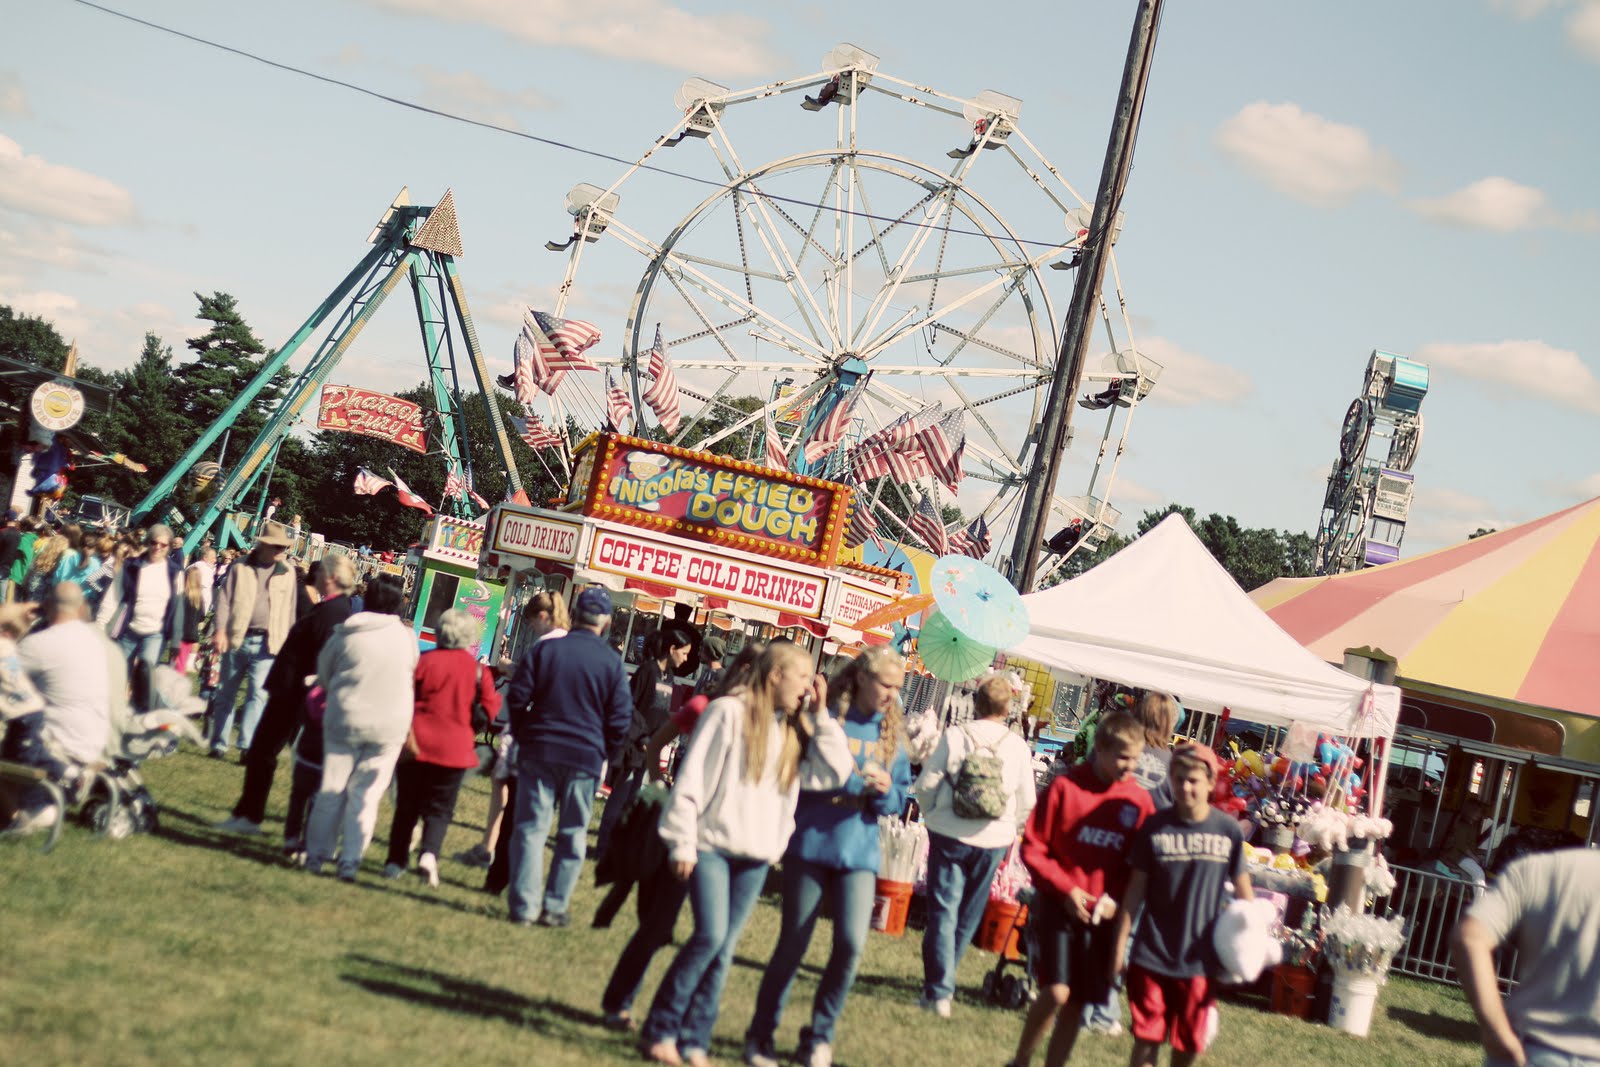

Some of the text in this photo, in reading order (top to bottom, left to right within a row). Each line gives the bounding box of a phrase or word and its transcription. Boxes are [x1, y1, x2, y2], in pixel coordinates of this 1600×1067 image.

[320, 387, 435, 431] Pharaoh's
[347, 409, 406, 439] Fury
[619, 467, 815, 513] Nicola's FRIED
[503, 520, 575, 555] COLD DRINKS
[691, 494, 818, 542] DOUGH
[599, 537, 818, 609] COFFEE COLD DRINKS
[838, 605, 862, 621] FRUIT
